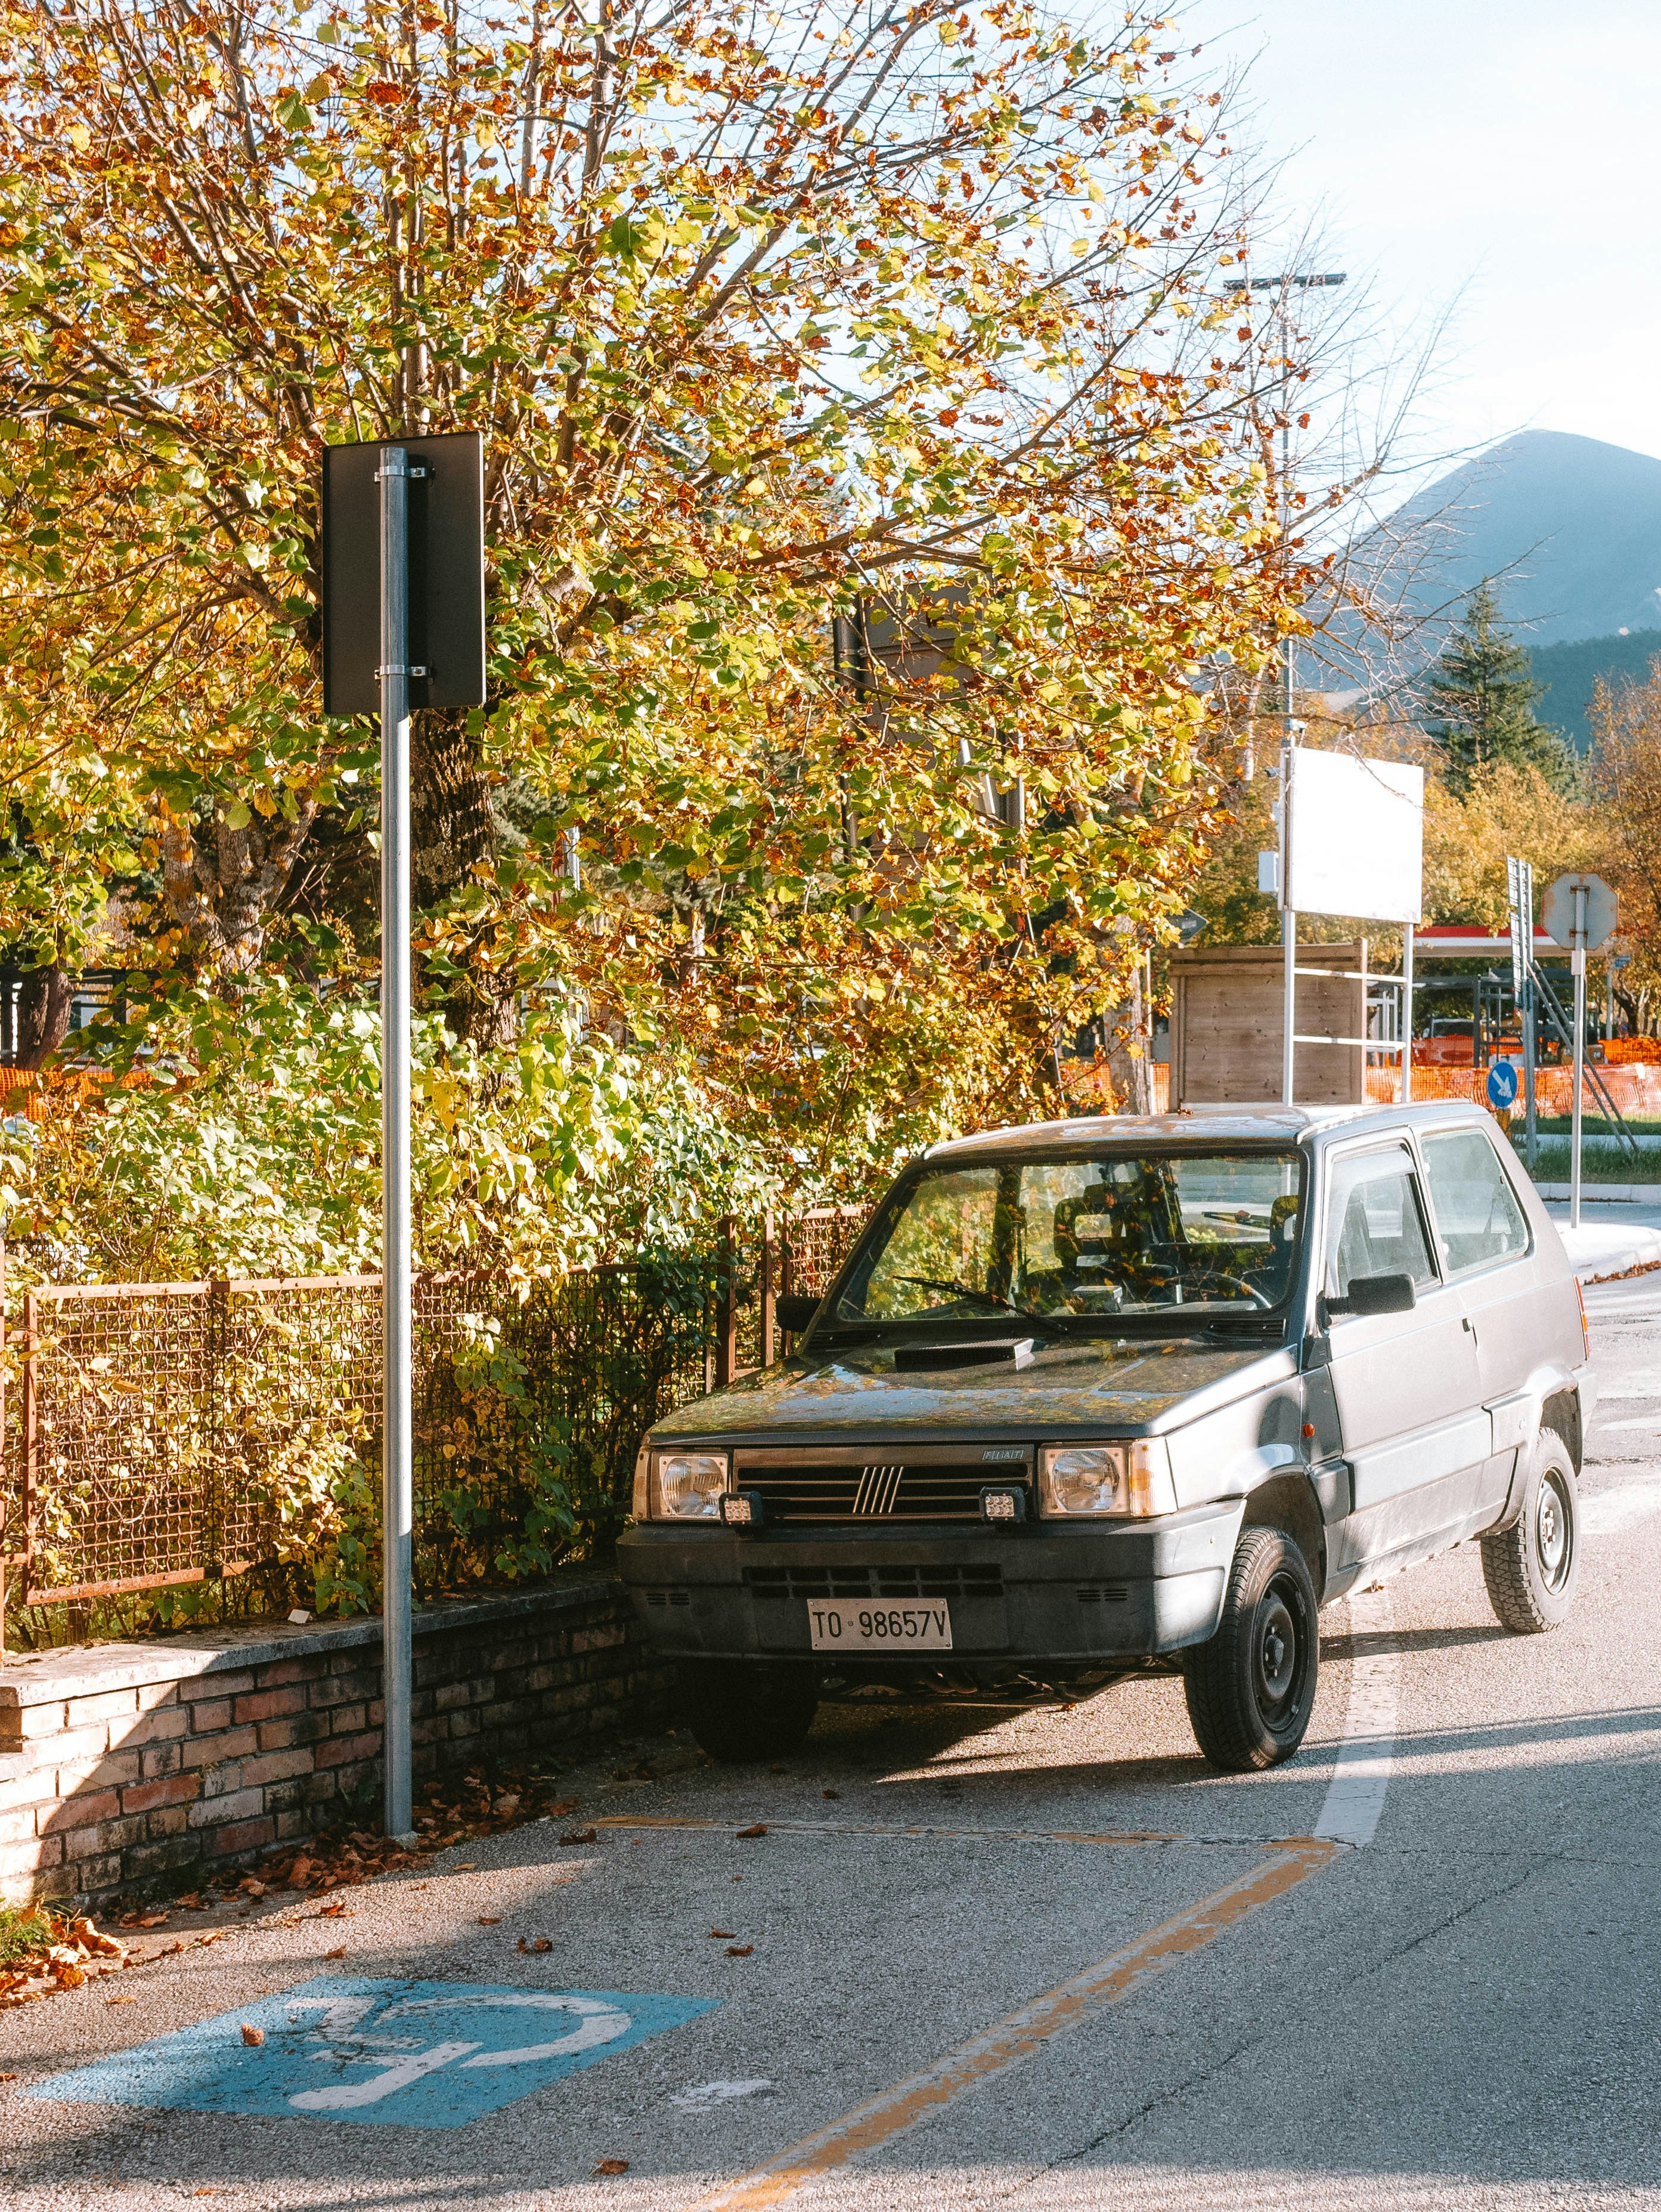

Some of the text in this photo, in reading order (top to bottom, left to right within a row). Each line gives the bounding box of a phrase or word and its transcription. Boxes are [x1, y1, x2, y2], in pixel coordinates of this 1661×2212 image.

[983, 1450, 1022, 1461] FIAT
[813, 1610, 946, 1638] TO 98657V
